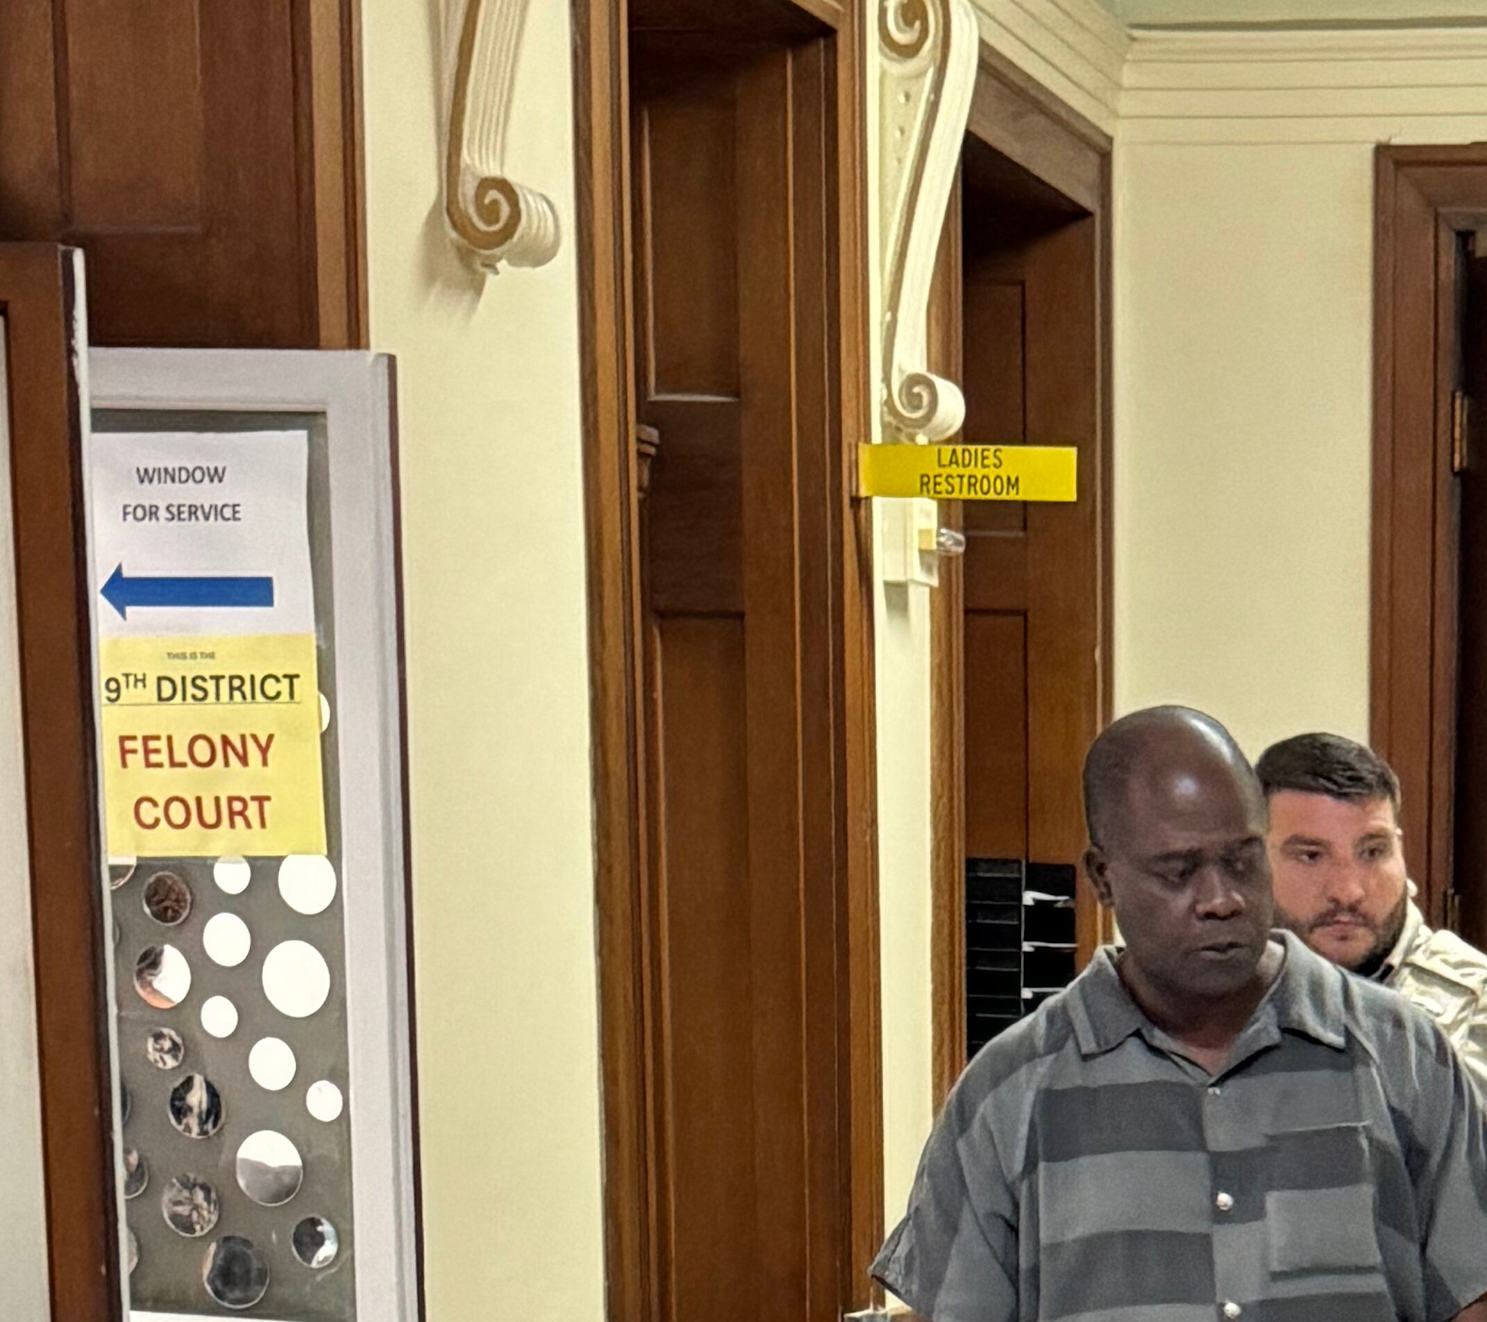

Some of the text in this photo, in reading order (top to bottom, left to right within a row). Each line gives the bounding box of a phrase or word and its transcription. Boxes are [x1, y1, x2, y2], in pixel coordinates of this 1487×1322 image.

[937, 448, 1003, 469] LADIES
[136, 466, 226, 485] WINDOW
[920, 474, 1020, 496] RESTROOM
[122, 503, 242, 523] FOR SERVICE
[157, 674, 300, 702] DISTRICT
[118, 732, 274, 769] FELONY
[134, 795, 271, 830] COURT
